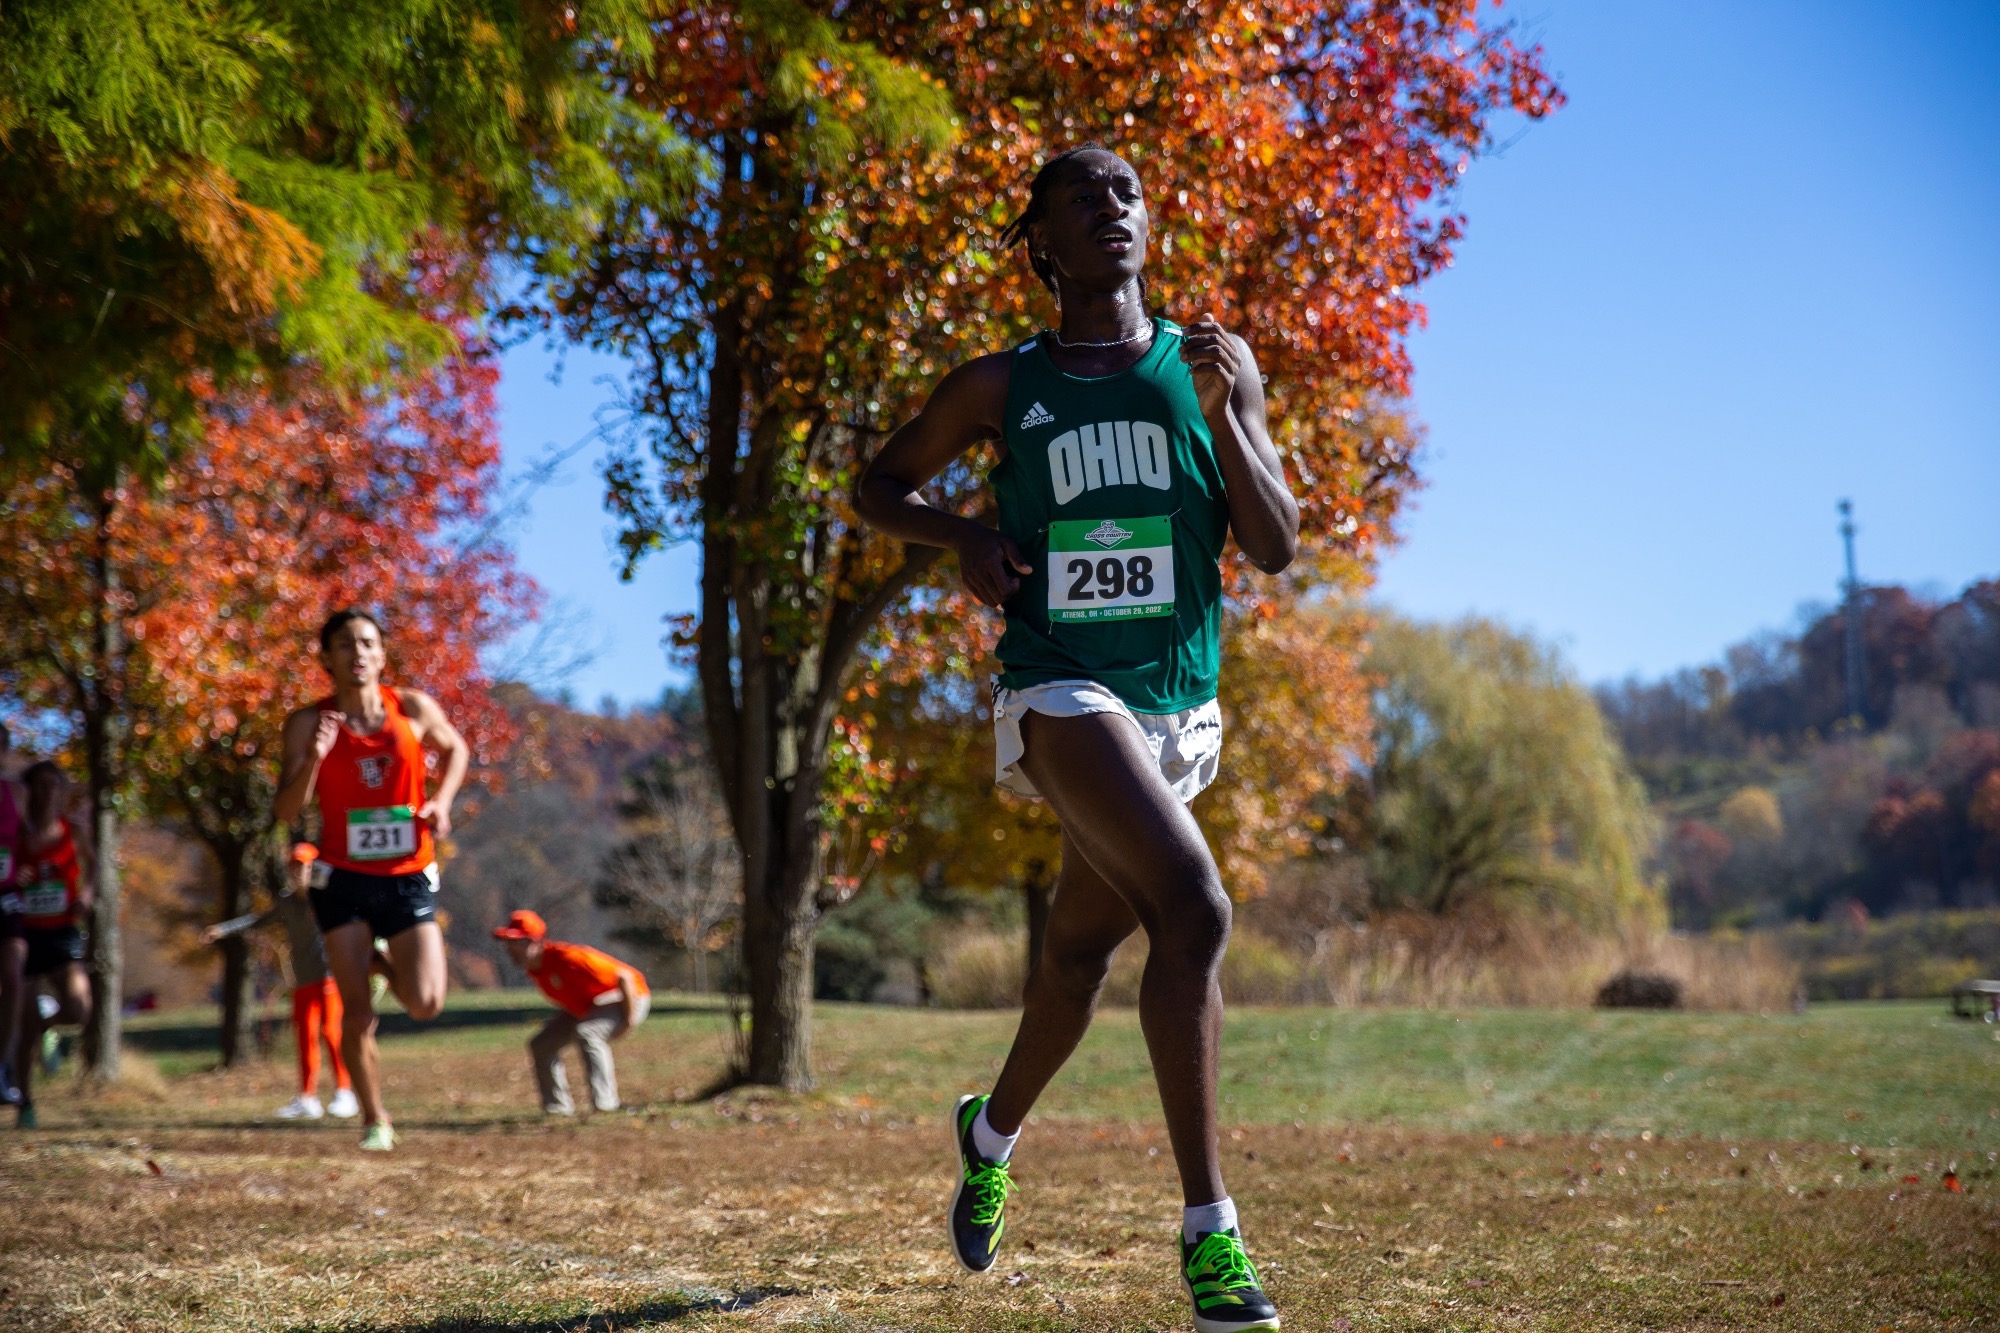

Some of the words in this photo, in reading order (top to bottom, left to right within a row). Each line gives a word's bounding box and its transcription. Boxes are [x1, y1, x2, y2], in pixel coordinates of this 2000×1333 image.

[1020, 413, 1055, 430] adidas
[1047, 420, 1171, 506] OHIO
[1066, 555, 1154, 601] 298
[1062, 610, 1087, 619] ATHENS,
[1103, 608, 1132, 617] OCTOBER
[1145, 605, 1162, 614] 2022
[358, 828, 402, 849] 231
